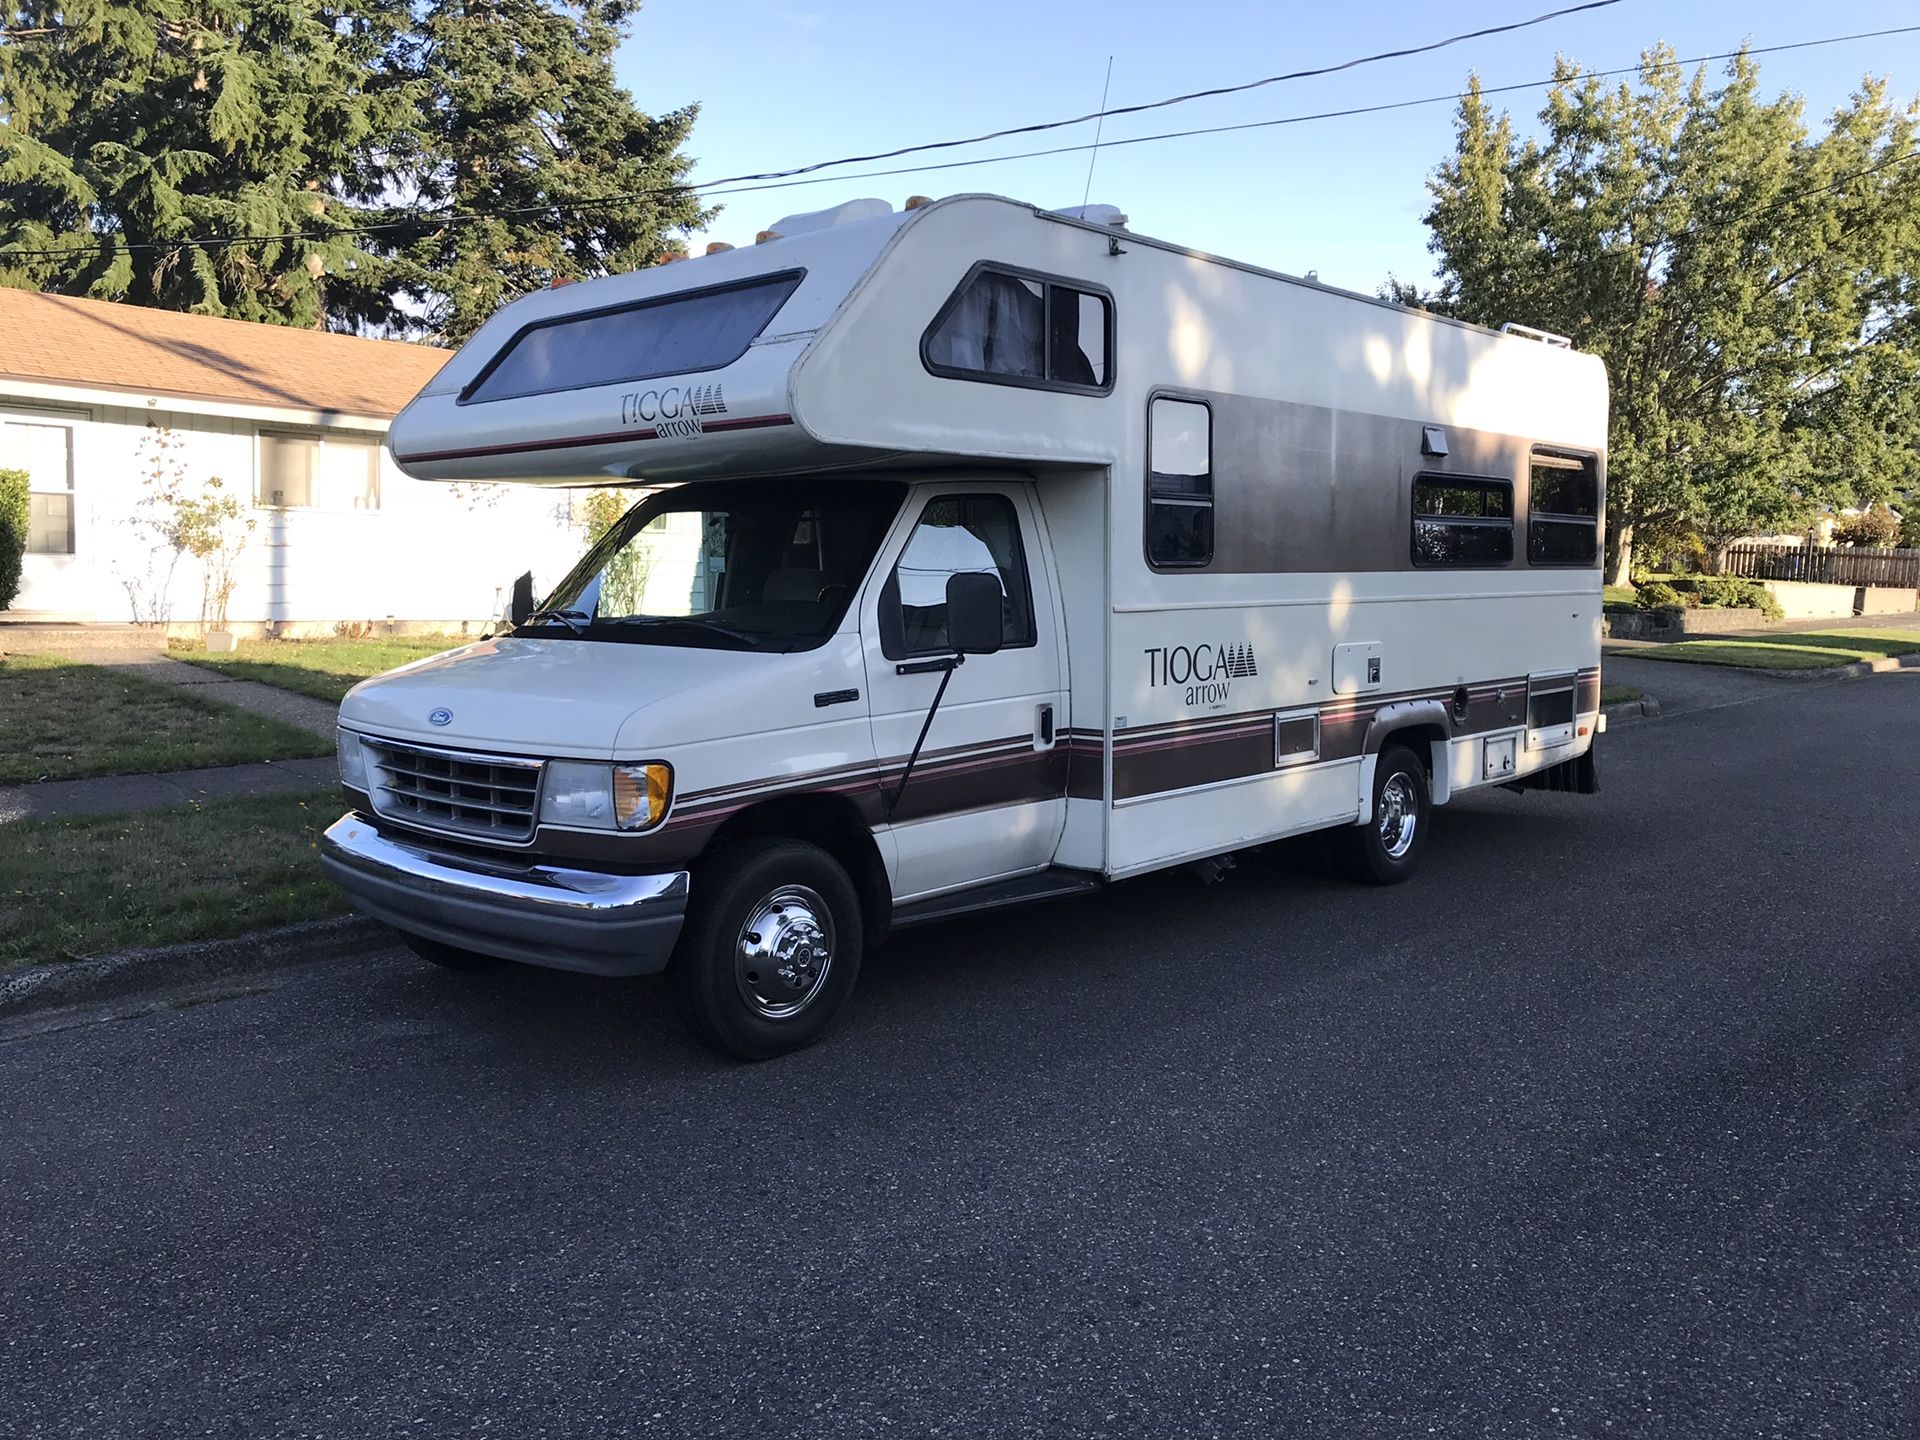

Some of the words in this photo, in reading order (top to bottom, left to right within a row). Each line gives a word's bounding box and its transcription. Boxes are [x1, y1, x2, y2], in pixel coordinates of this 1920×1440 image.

[656, 419, 702, 439] arrow
[1144, 643, 1230, 687] TIOGA
[1185, 682, 1230, 706] arrow
